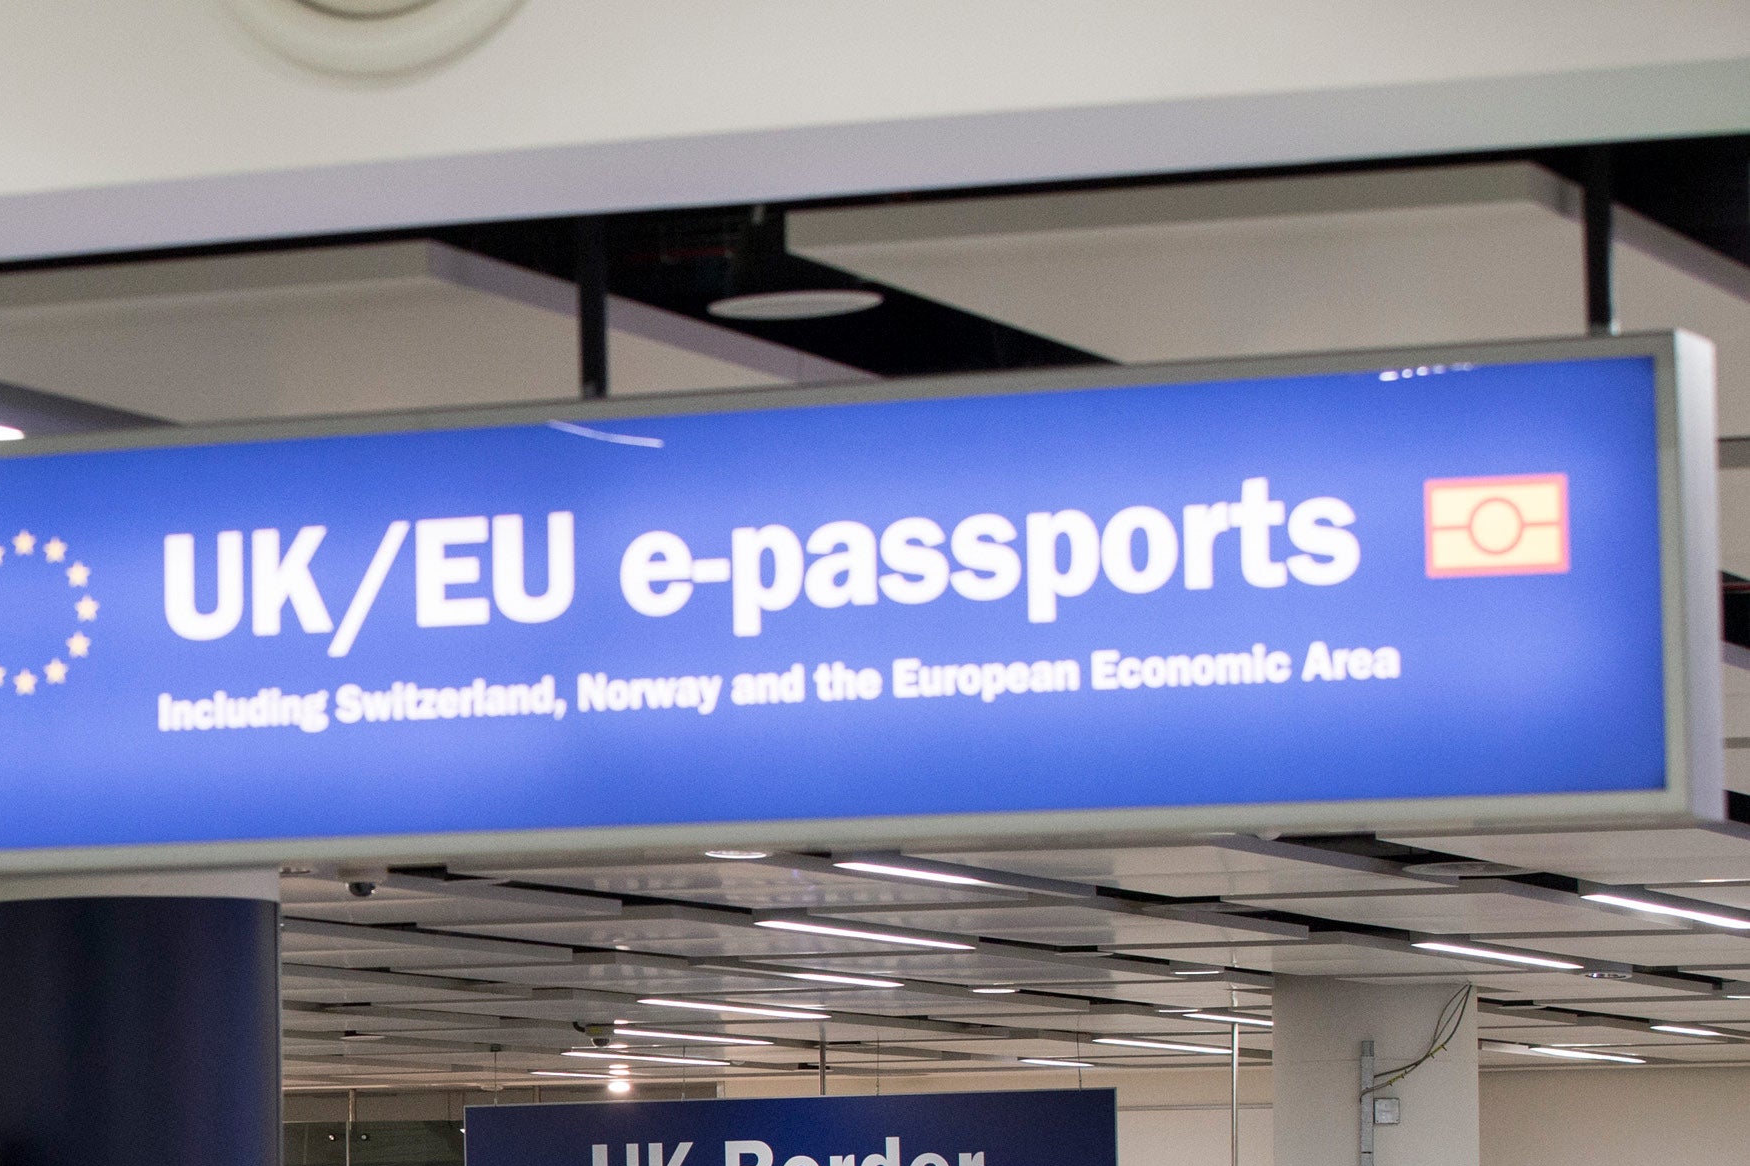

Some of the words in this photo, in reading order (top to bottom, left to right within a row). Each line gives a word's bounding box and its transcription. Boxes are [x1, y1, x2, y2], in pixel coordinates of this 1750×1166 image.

[163, 511, 575, 657] UK/EU
[619, 476, 1361, 638] e-passports
[158, 688, 329, 733] Including
[335, 675, 567, 723] Switzerland,
[578, 671, 723, 715] Norway
[731, 663, 805, 703] and
[813, 661, 882, 700] the
[892, 657, 1080, 702] European
[1091, 642, 1292, 690] Economic
[1301, 640, 1401, 681] Area
